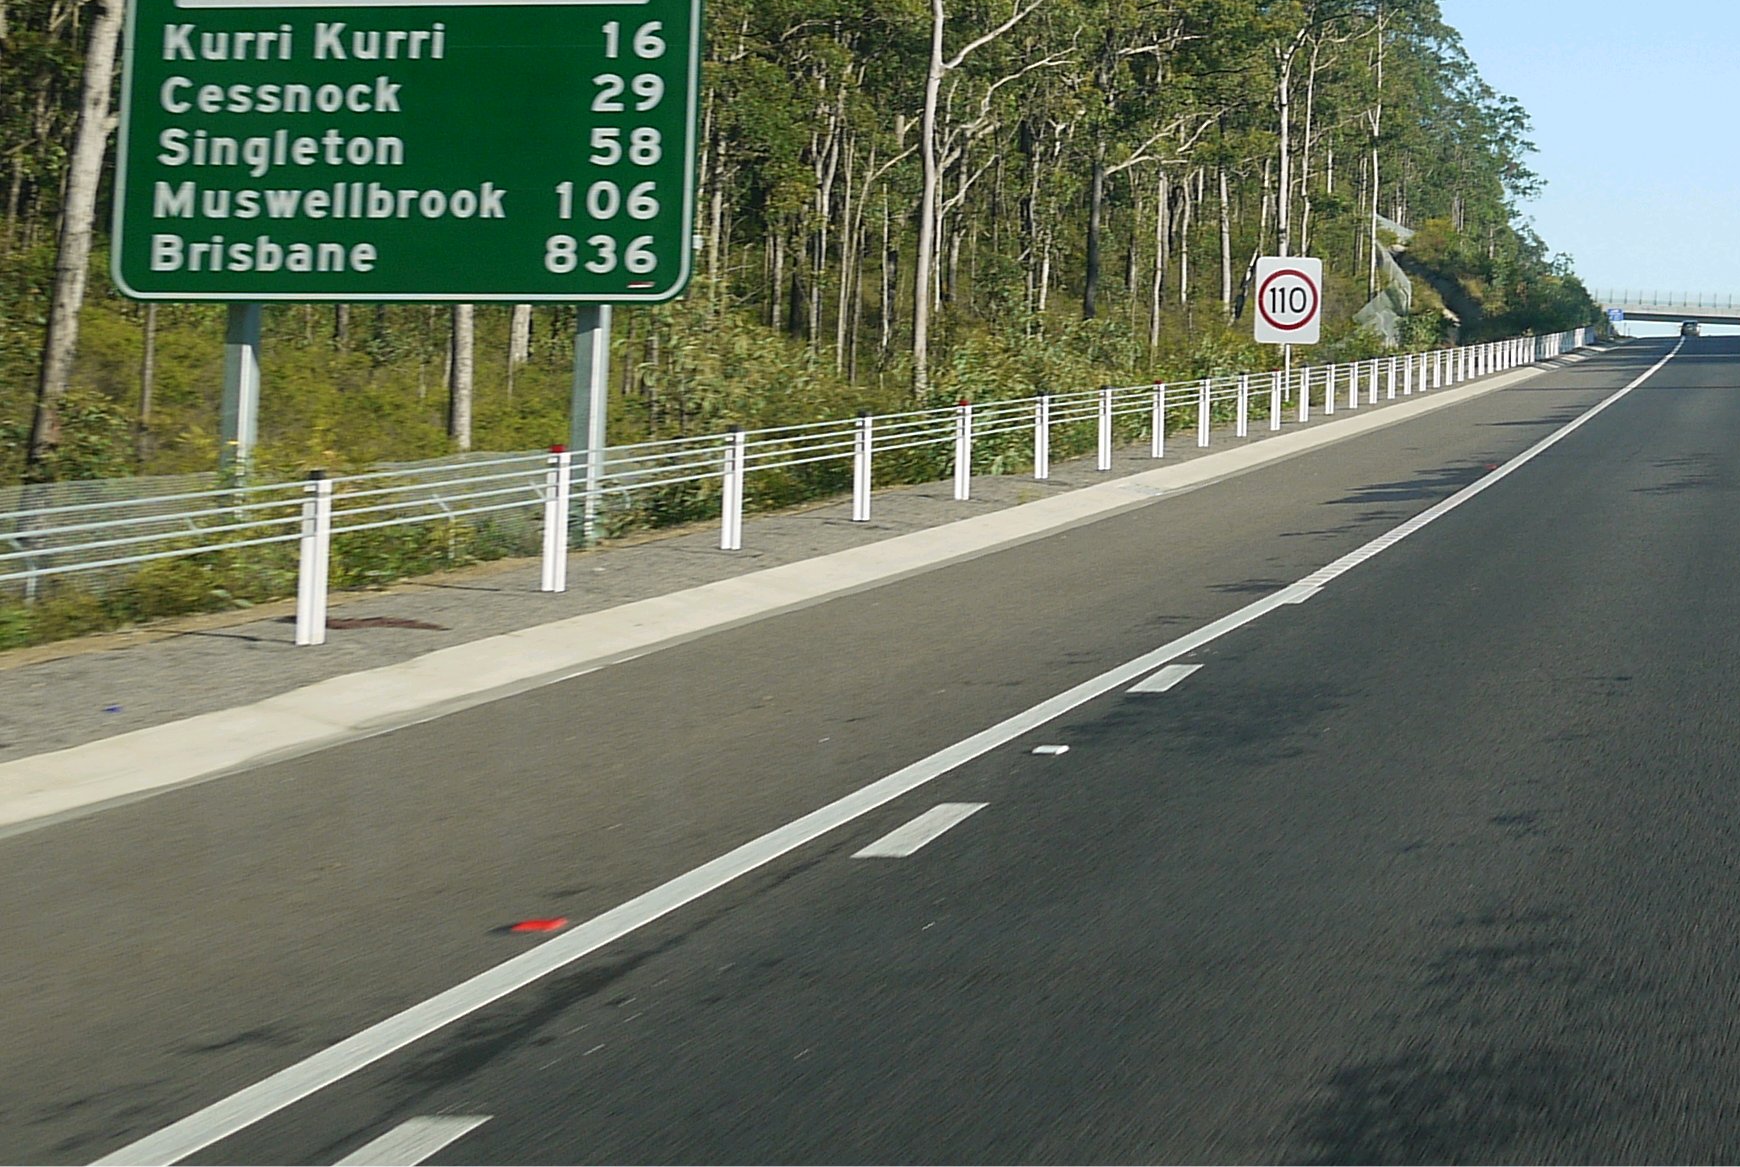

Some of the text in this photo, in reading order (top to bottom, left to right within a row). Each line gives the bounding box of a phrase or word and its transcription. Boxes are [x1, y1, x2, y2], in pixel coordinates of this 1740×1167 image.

[163, 22, 444, 60] Kurri Kurri
[602, 20, 666, 59] 16
[160, 76, 401, 113] Cessnock
[591, 73, 664, 112] 29
[157, 128, 403, 177] Singleton
[589, 126, 662, 166] 58
[153, 181, 507, 219] Muswellbrook
[556, 180, 660, 220] 106
[151, 234, 377, 272] Brisbane
[544, 234, 657, 273] 836
[1269, 286, 1307, 314] 110
